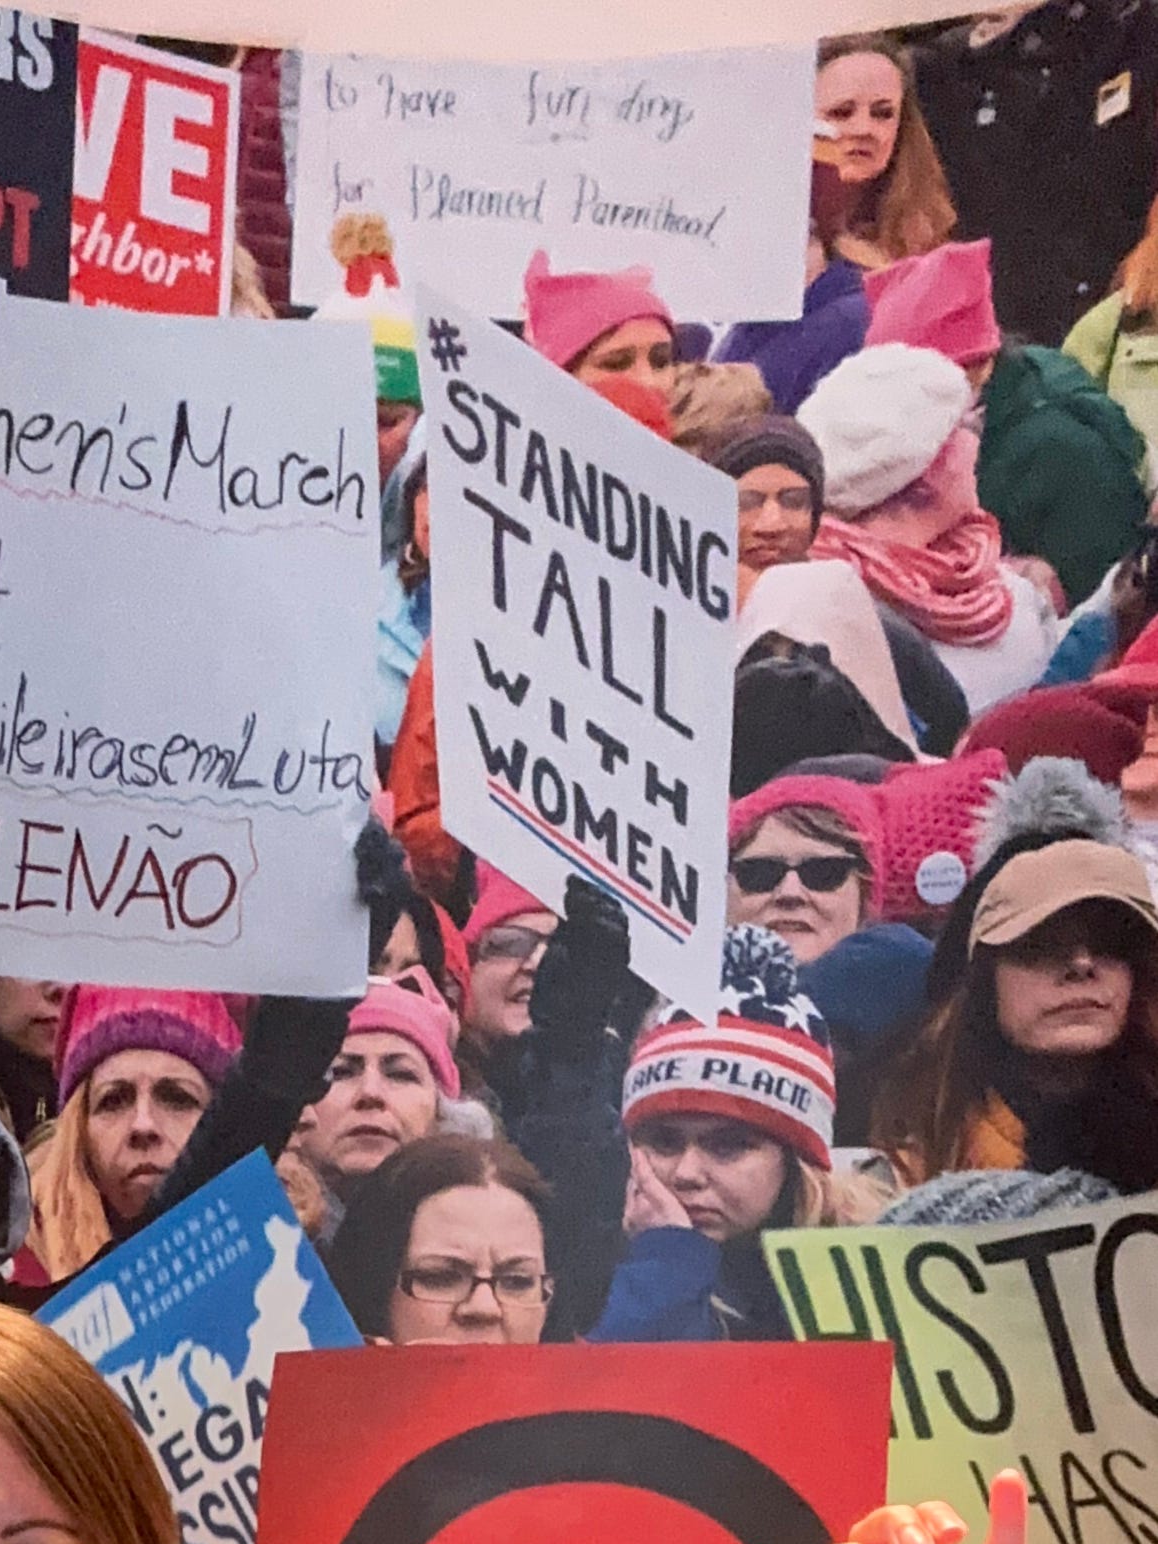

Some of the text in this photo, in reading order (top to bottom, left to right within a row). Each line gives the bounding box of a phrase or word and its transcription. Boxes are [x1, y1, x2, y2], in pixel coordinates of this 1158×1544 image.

[73, 62, 214, 235] VE
[443, 379, 731, 621] STANDING
[463, 488, 694, 740] TALL
[468, 704, 700, 927] WOMEN
[473, 638, 690, 827] WITH
[626, 1056, 812, 1114] AKE PLACID
[118, 1198, 231, 1286] NATIONAL
[130, 1214, 240, 1306] ABORTION
[138, 1234, 250, 1328] FEDERATION
[776, 1212, 1158, 1440] HISTO
[158, 1377, 269, 1494] EGA
